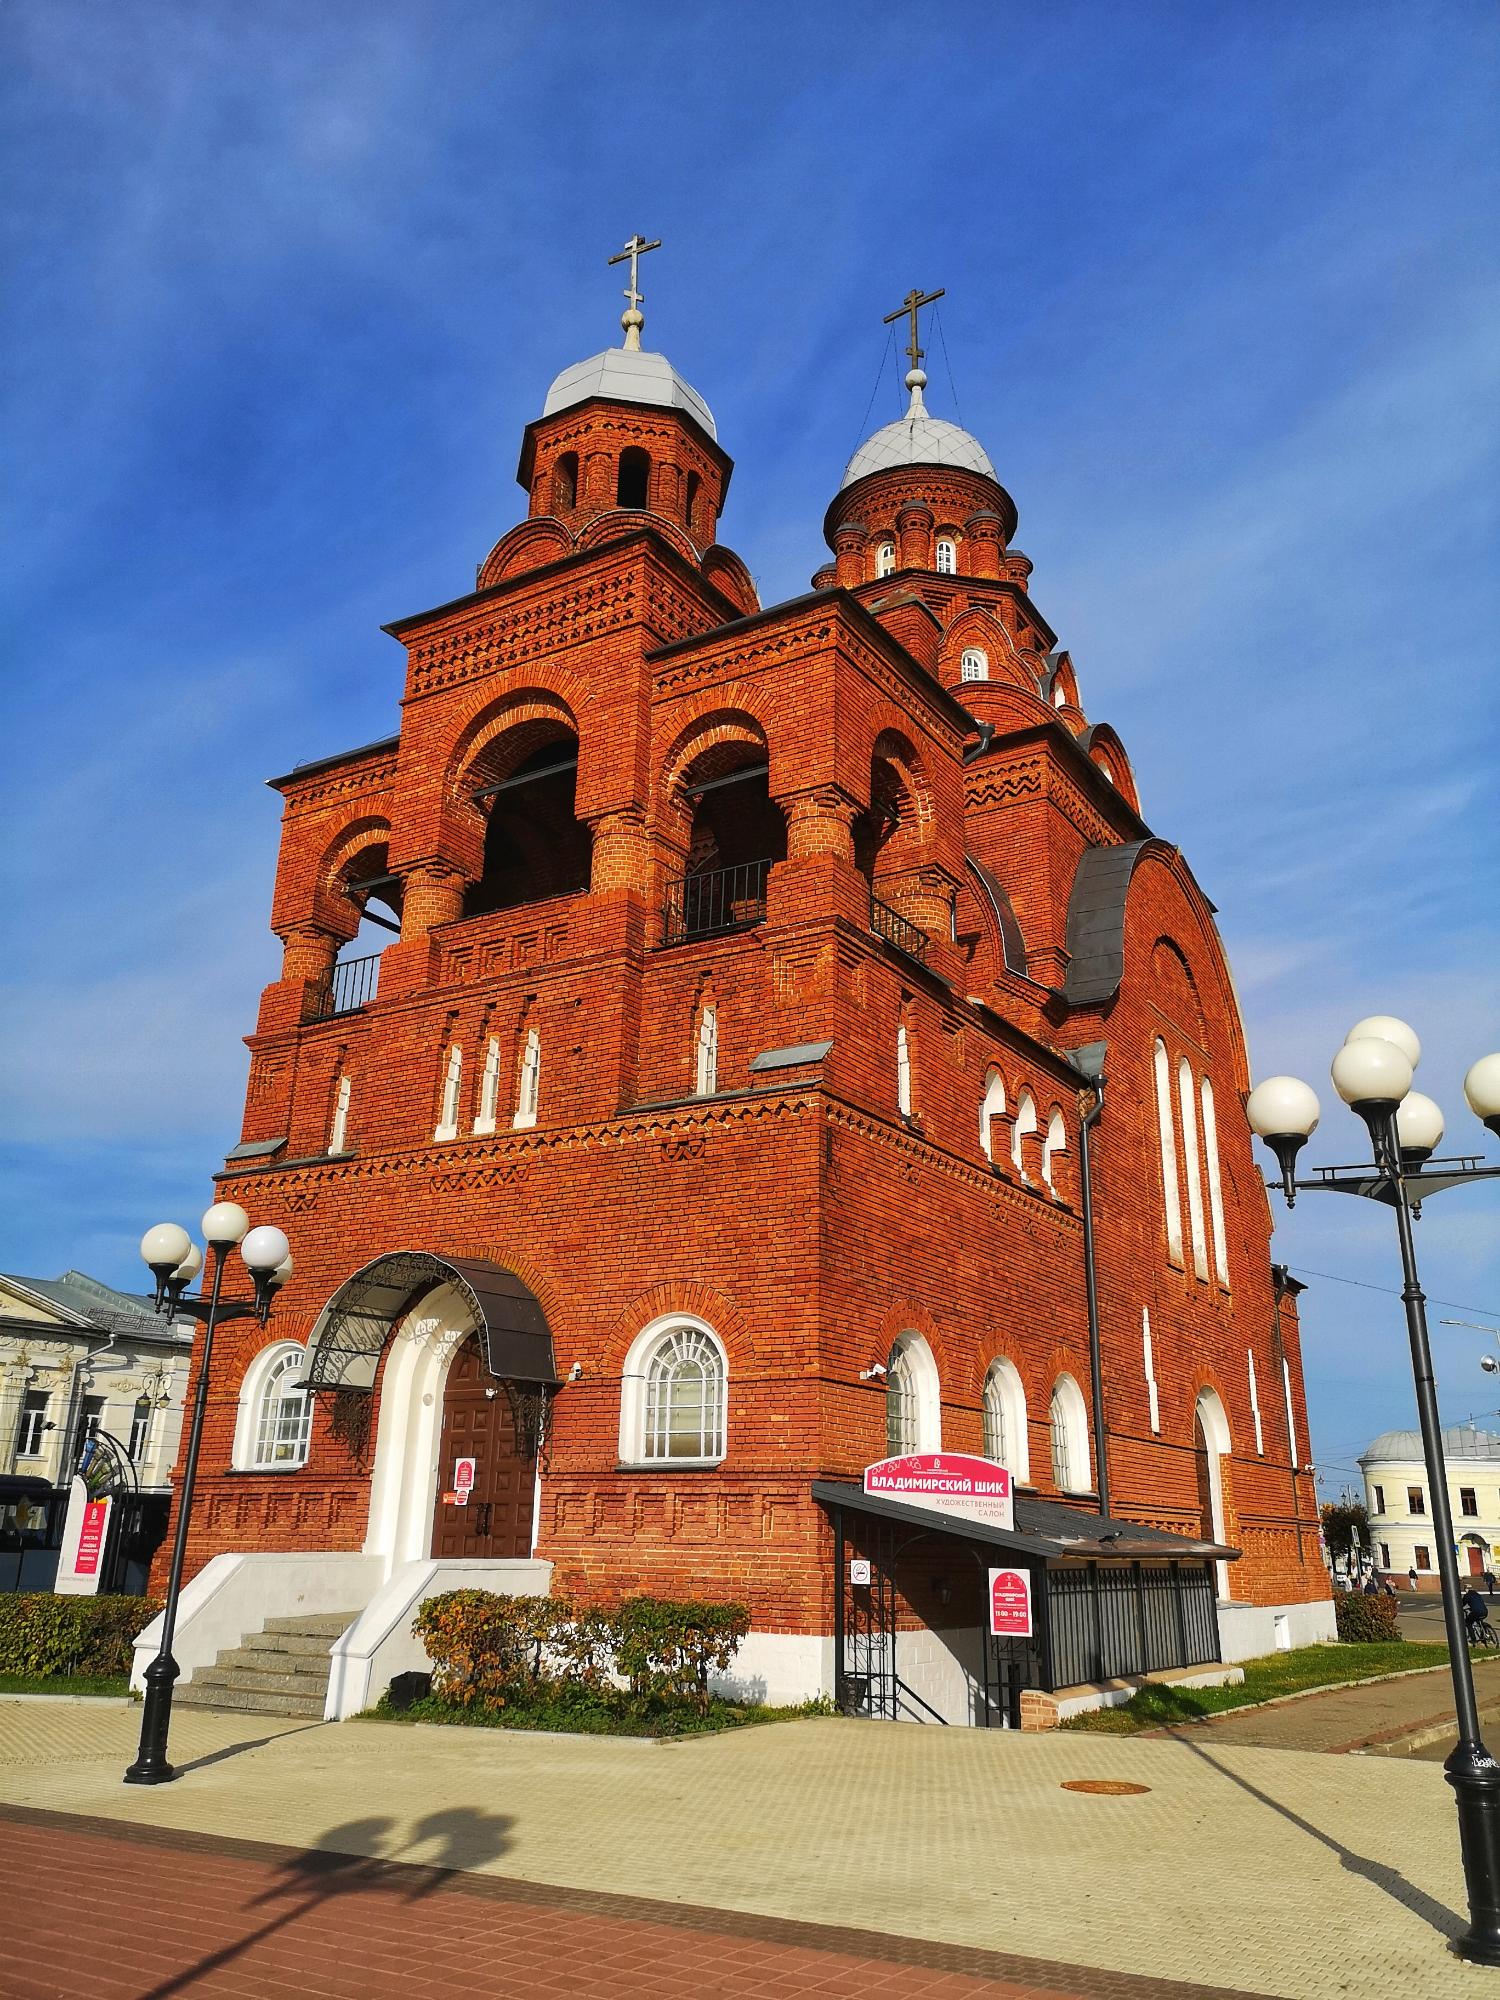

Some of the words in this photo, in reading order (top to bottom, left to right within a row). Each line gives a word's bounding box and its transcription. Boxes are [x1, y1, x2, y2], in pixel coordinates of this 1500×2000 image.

[871, 1476, 972, 1493] ВЛАДИМИРСКИЙ
[974, 1481, 1004, 1494] ШИК
[935, 1498, 1005, 1509] ХУДОЖЕСТВЕННЫЙ
[978, 1509, 1005, 1517] САЛОН
